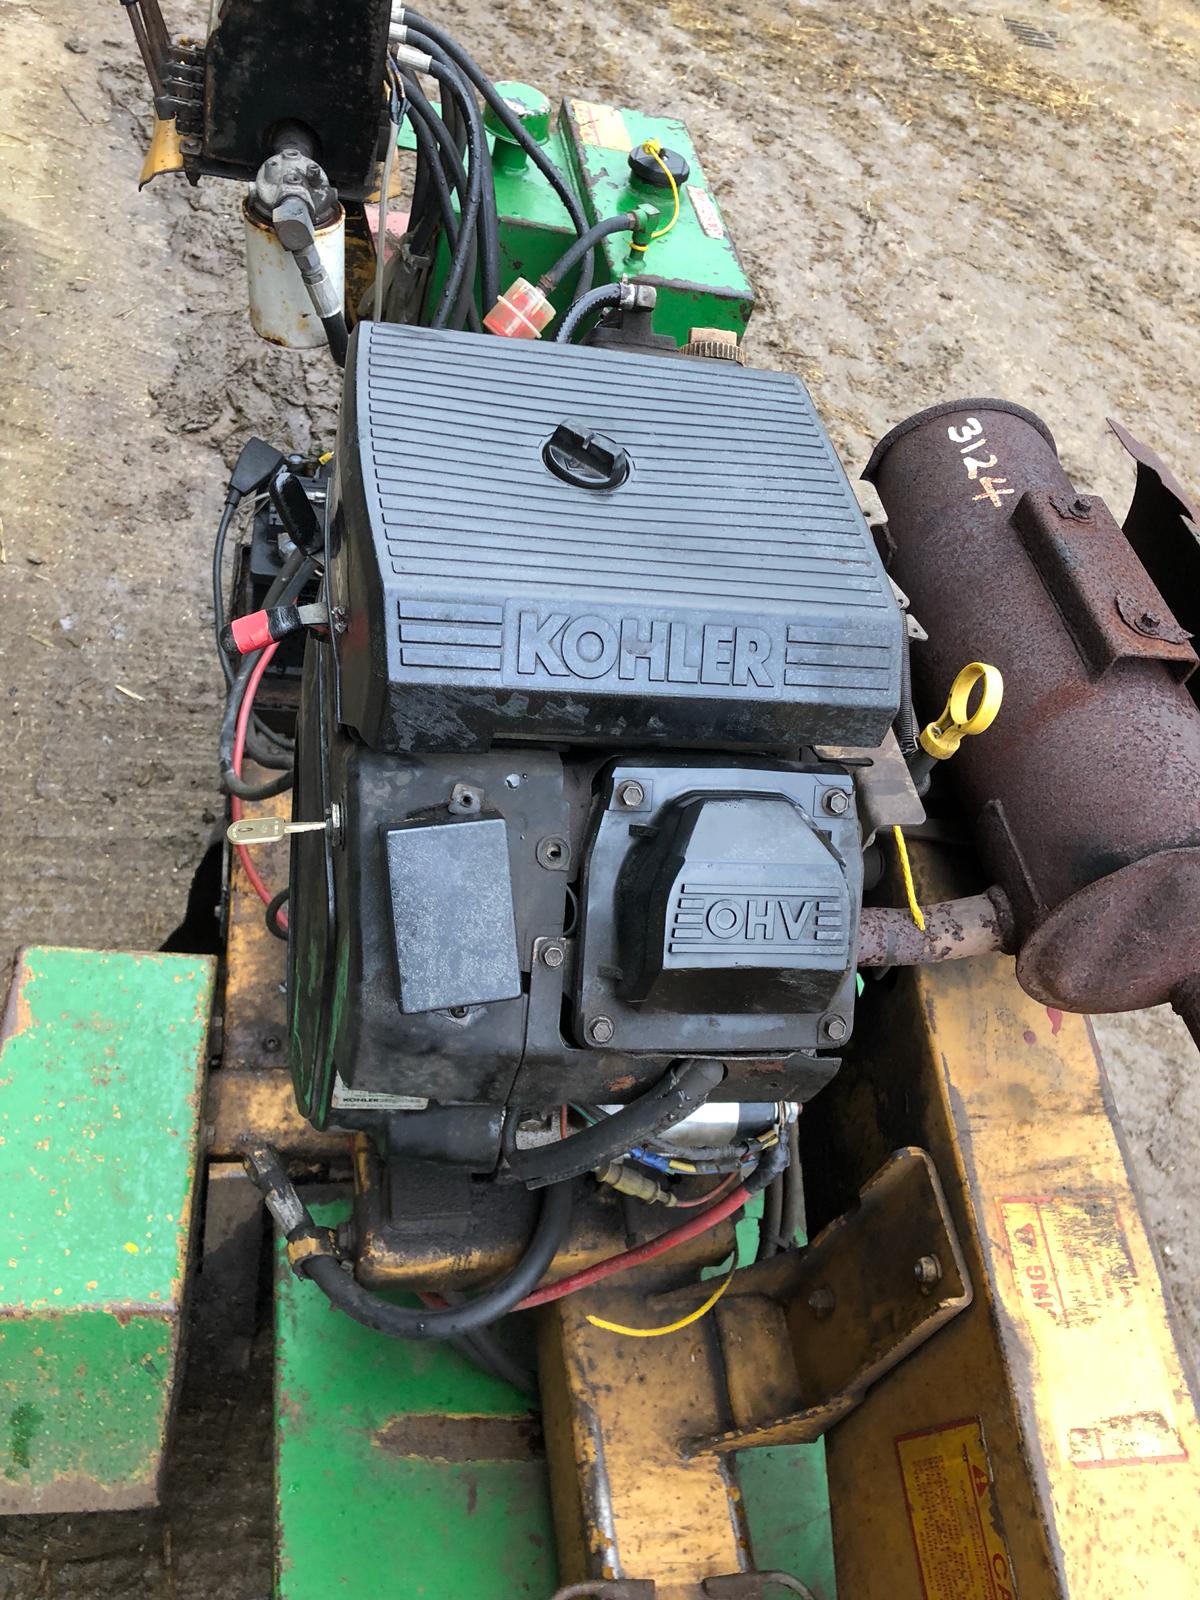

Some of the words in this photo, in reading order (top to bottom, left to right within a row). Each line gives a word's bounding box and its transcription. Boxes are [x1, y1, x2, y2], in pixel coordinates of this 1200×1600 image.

[948, 418, 1015, 507] 3124
[518, 611, 774, 687] KOHLER
[706, 899, 815, 940] OHV
